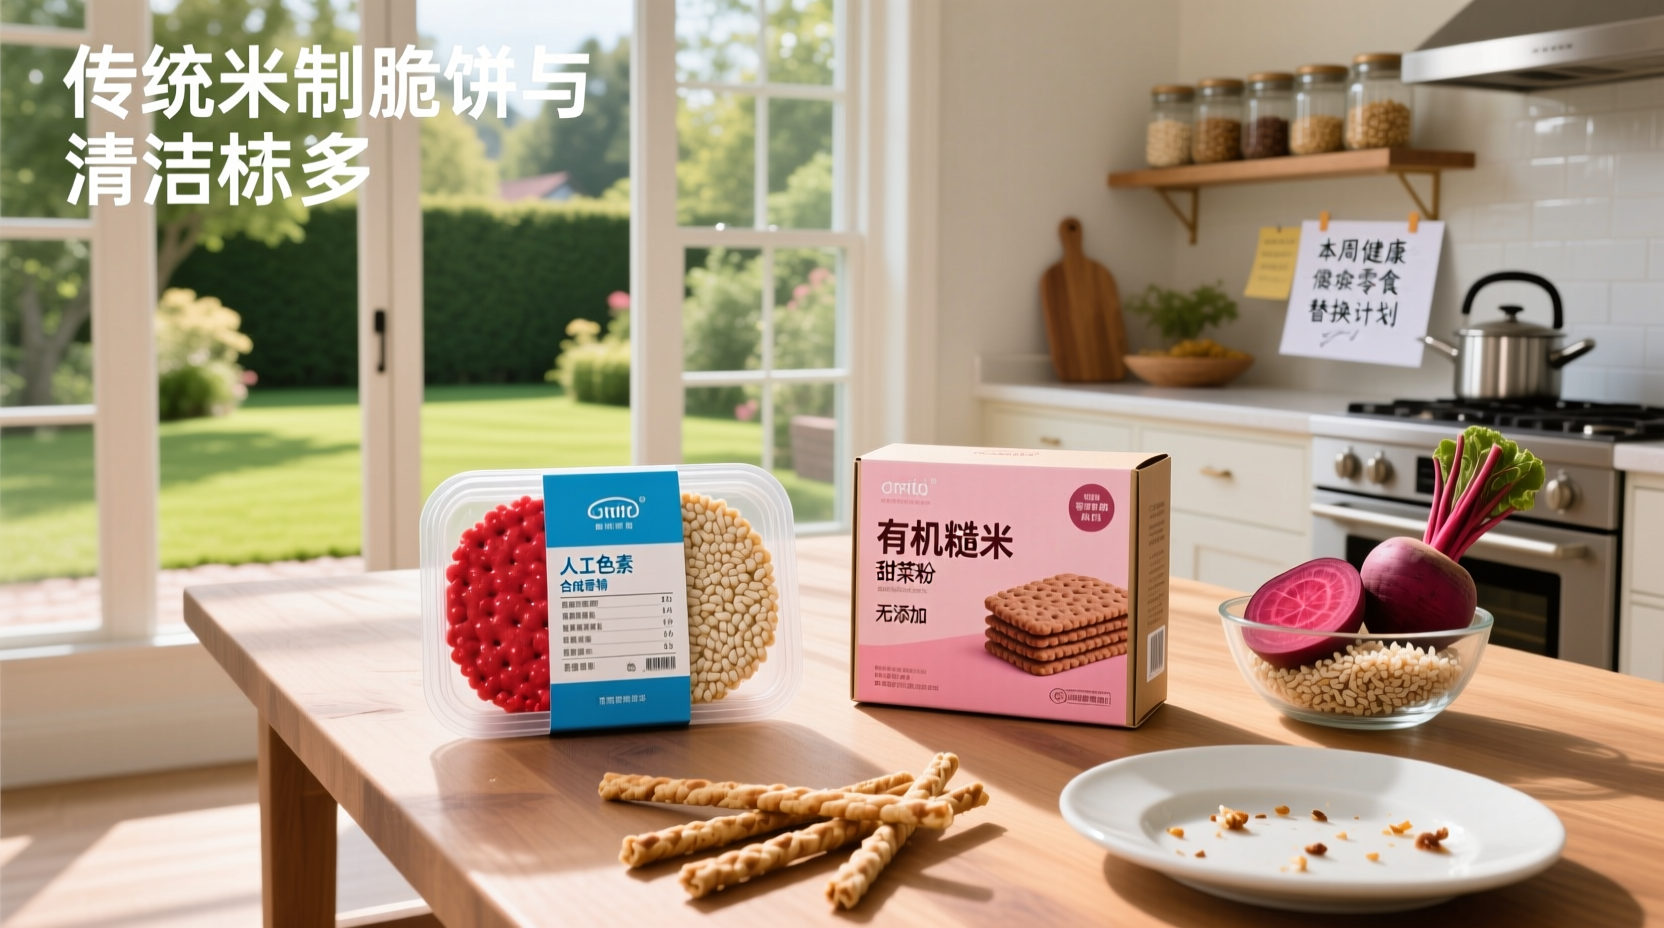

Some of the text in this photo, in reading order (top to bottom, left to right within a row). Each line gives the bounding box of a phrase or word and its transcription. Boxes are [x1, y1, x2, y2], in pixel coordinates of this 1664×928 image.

[1318, 238, 1407, 264] 本周健康
[1309, 299, 1398, 327] 替换计划
[877, 518, 1014, 560] 有机糙米
[560, 554, 634, 576] 人工色素
[875, 604, 928, 625] 无添加
